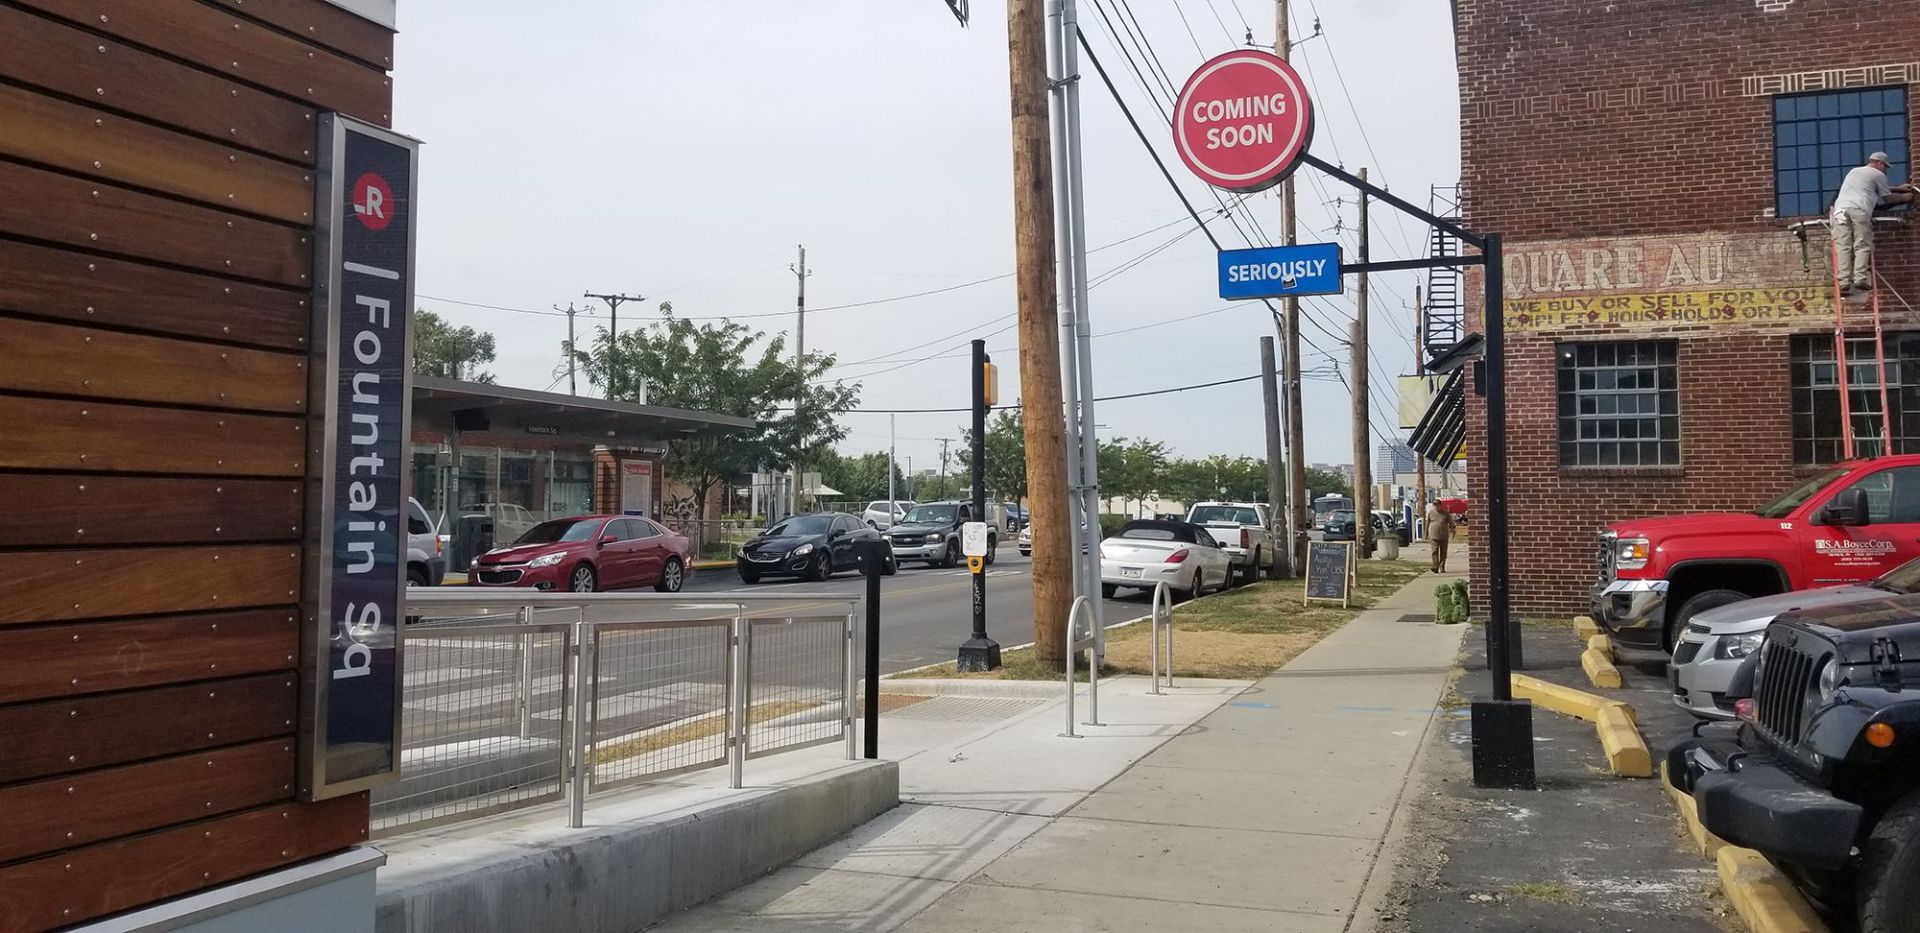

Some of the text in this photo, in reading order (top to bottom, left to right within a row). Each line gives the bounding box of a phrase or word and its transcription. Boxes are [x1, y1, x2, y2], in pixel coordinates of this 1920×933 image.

[1192, 93, 1286, 123] COMING
[1206, 123, 1273, 150] SOON
[1228, 259, 1327, 283] SERIOUSLY
[1503, 245, 1645, 299] QUARE
[1510, 301, 1541, 313] WE
[1547, 298, 1593, 312] BUY
[1600, 296, 1631, 309] OR
[1641, 294, 1699, 309] SELL
[1708, 291, 1755, 305] FOR
[1743, 305, 1773, 319] OR
[333, 293, 391, 680] Fountain Sq
